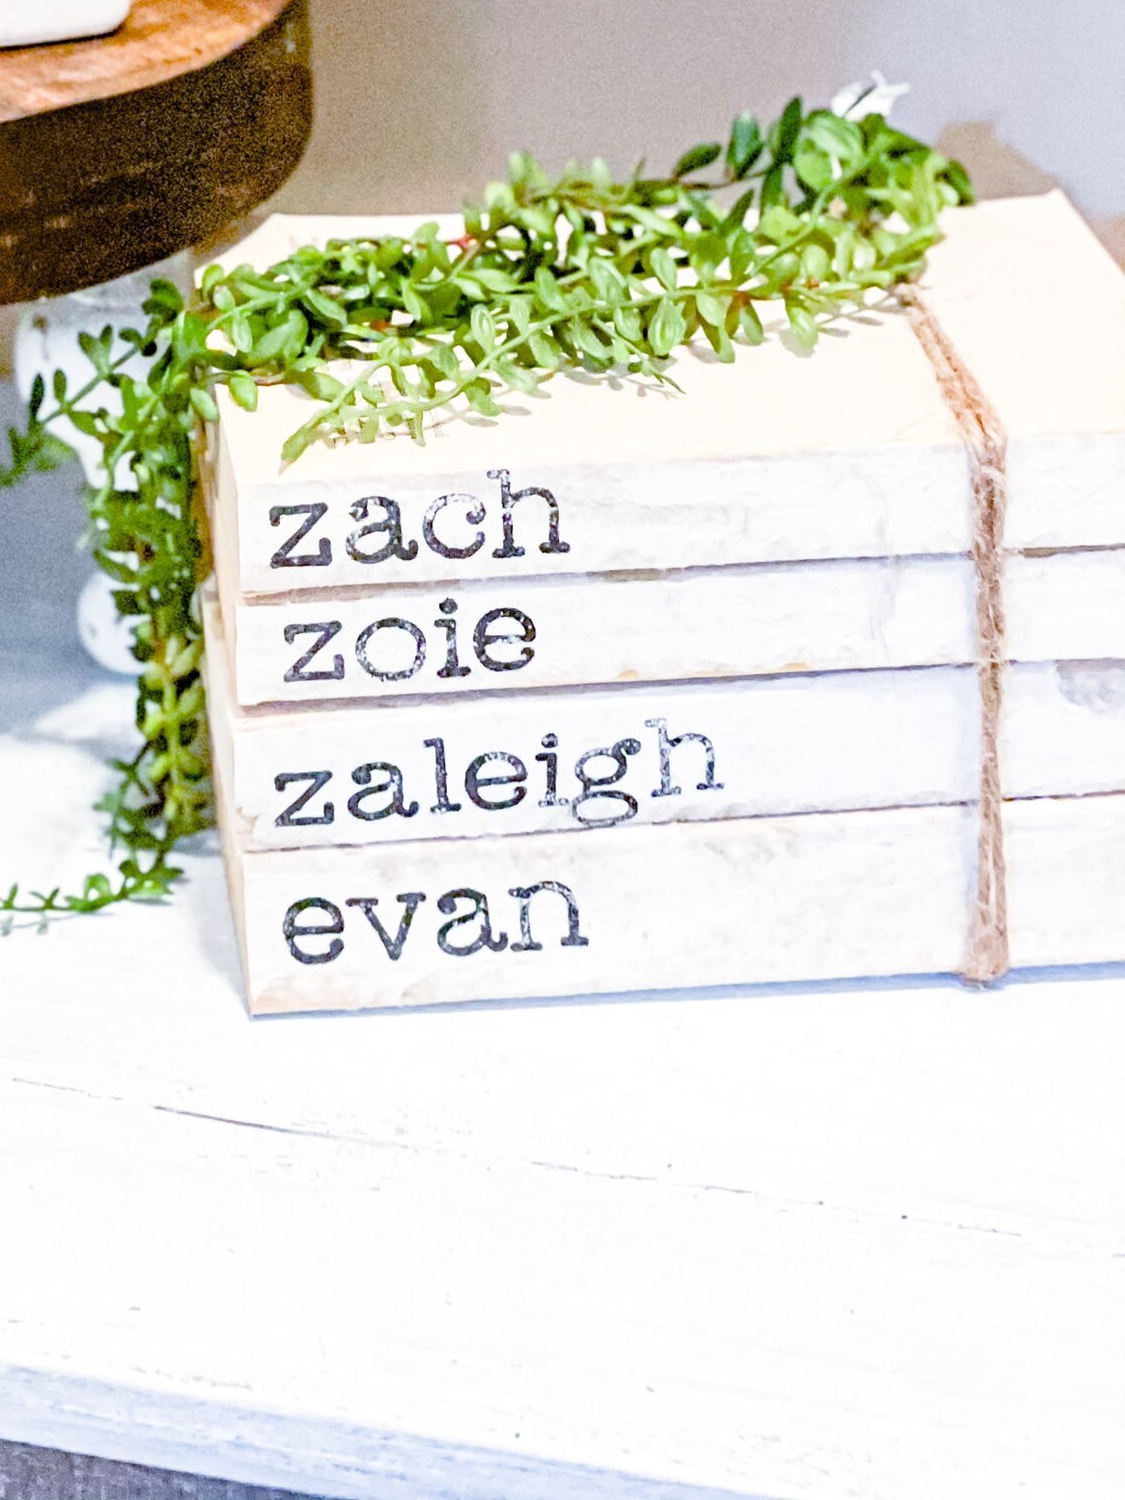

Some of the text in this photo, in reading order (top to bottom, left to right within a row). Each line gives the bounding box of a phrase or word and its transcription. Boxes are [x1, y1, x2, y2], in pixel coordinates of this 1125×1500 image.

[268, 469, 572, 570] zach
[282, 596, 538, 683] zoie
[273, 717, 726, 828] zaleigh
[282, 879, 590, 966] evan
